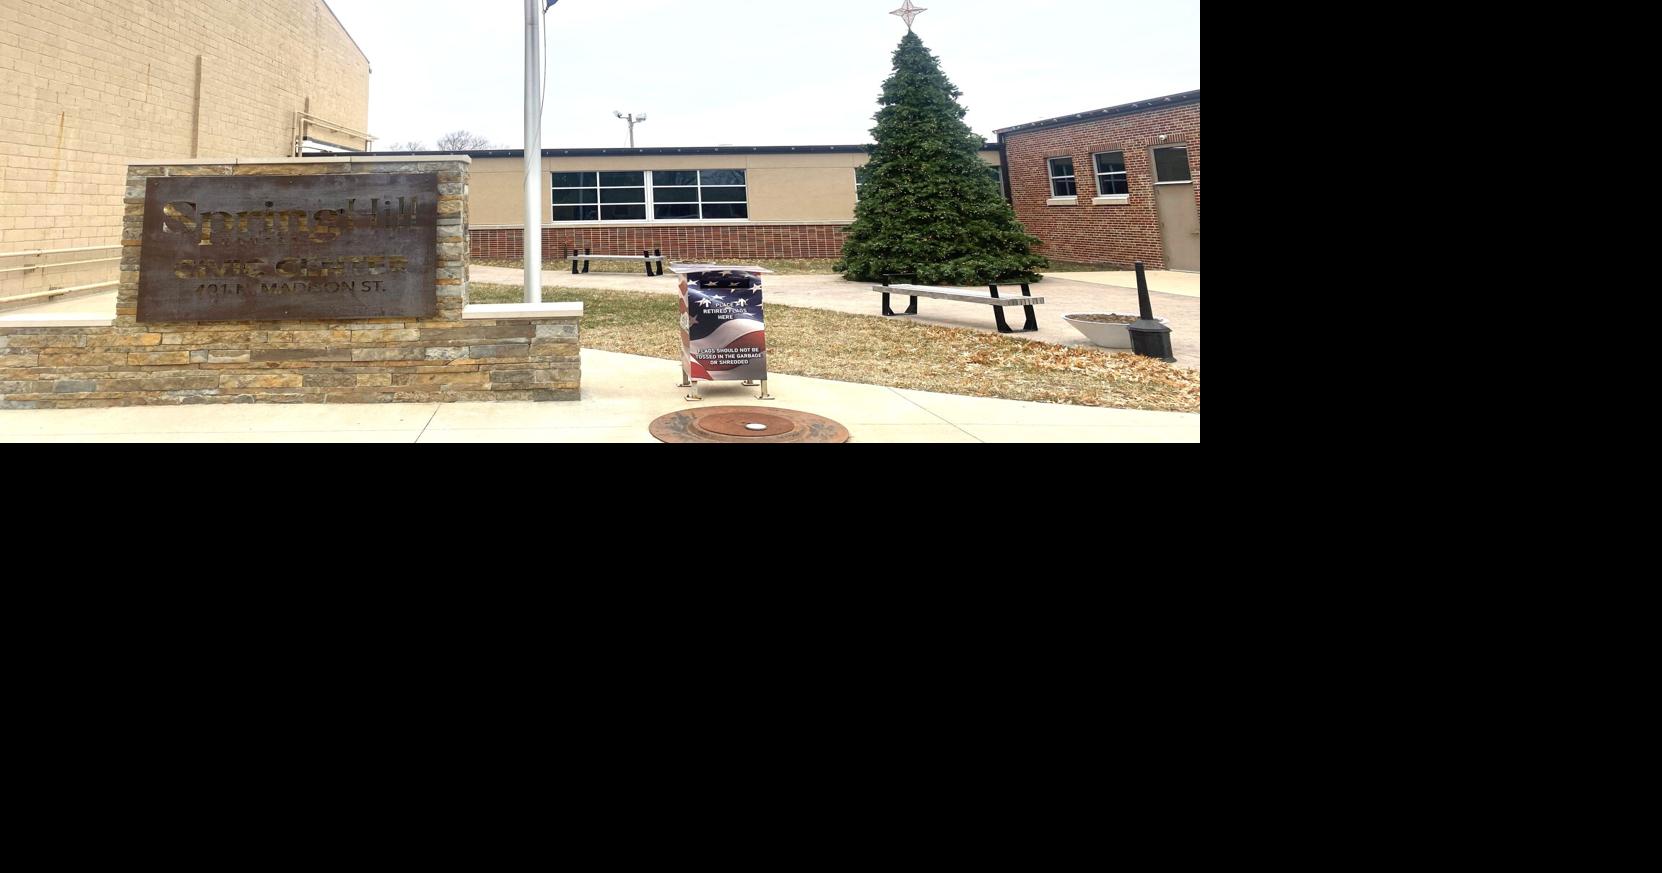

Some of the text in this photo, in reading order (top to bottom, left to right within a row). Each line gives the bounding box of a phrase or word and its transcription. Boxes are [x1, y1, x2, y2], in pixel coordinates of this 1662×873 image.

[174, 255, 409, 280] CIVIC CENTER
[261, 280, 355, 295] MADISON
[361, 280, 386, 293] ST.
